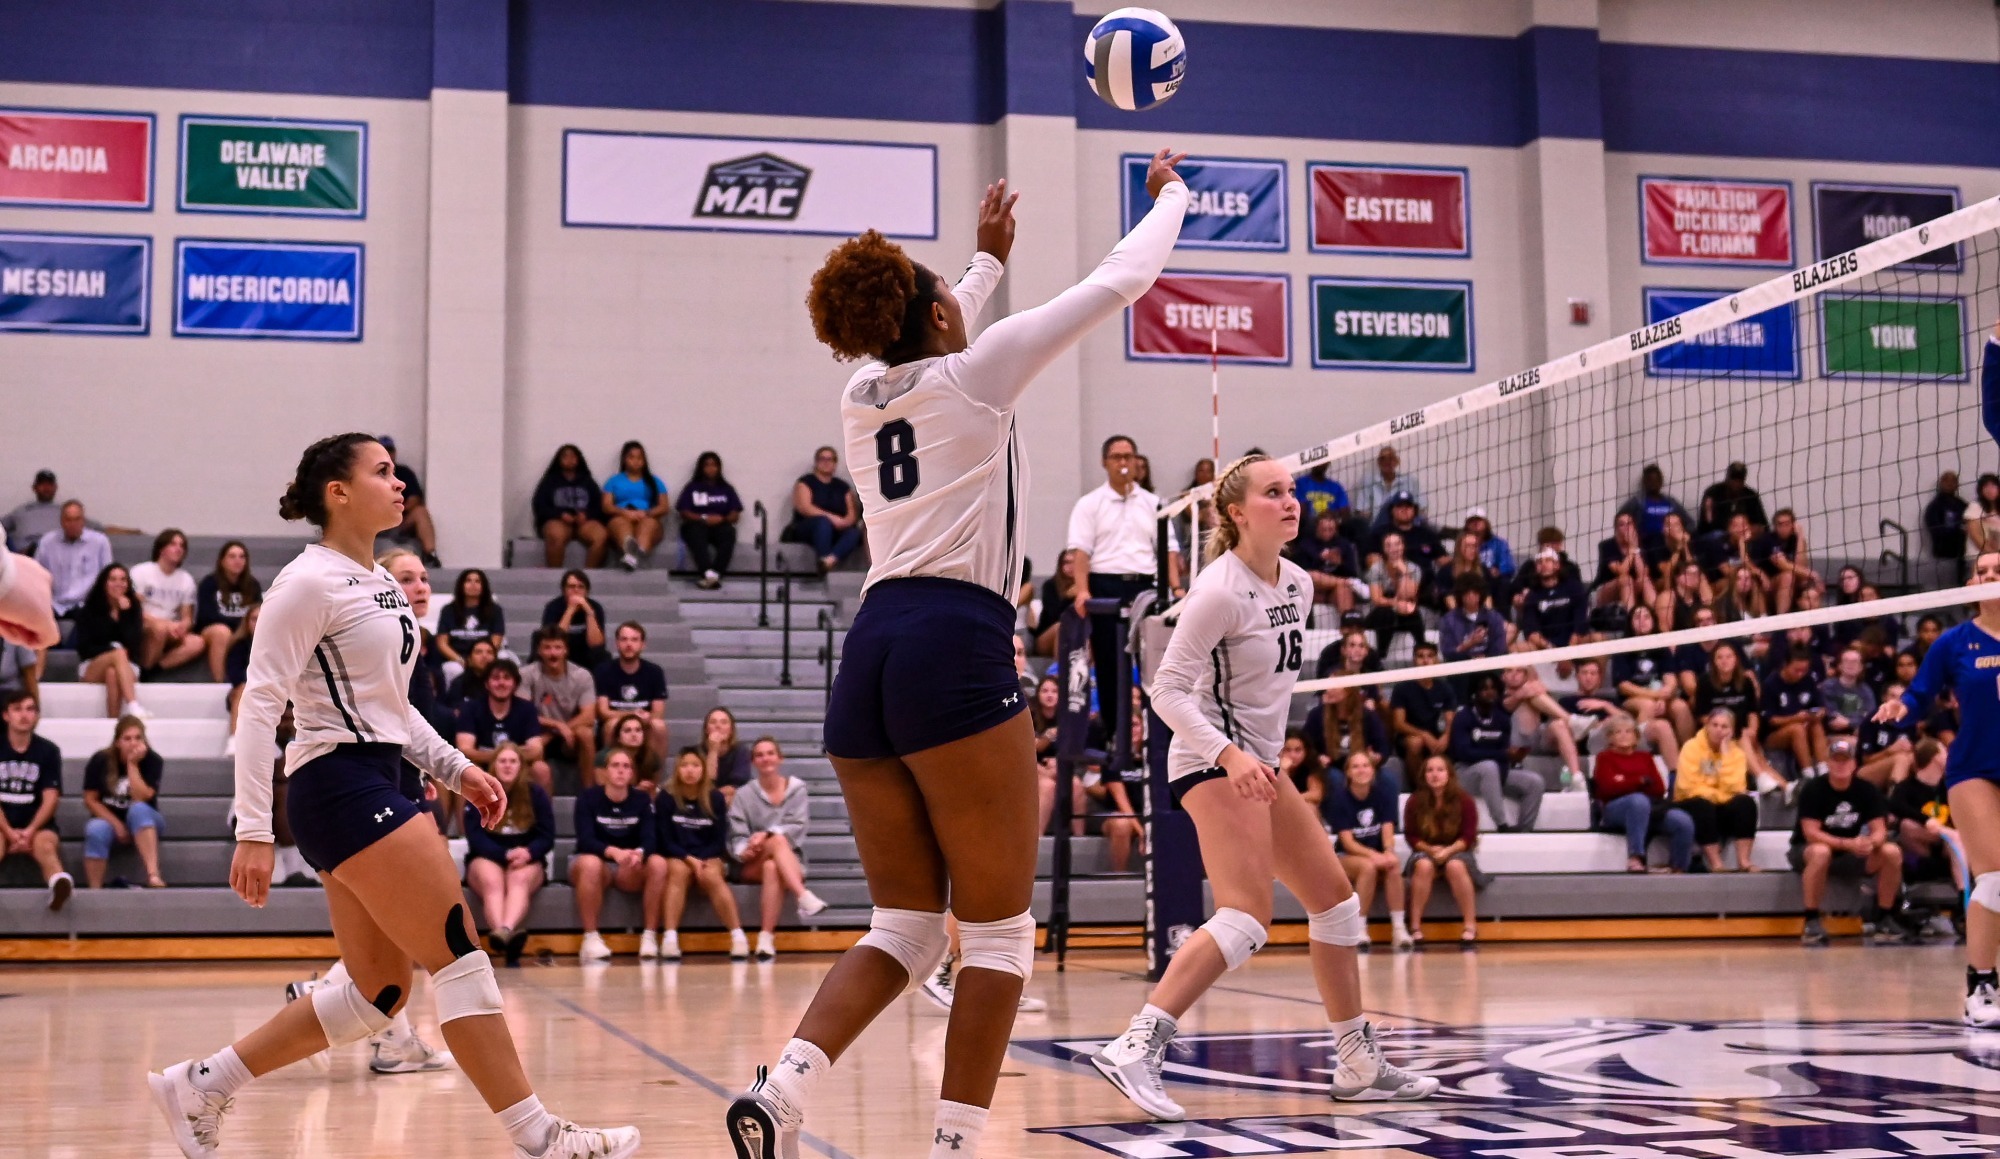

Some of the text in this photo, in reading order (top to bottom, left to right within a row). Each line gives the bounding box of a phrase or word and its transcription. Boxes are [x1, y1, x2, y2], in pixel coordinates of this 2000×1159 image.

[8, 145, 108, 174] ARCADIA
[220, 140, 326, 168] DELAWARE
[236, 166, 310, 191] VALLEY
[701, 184, 799, 216] MAC
[1345, 197, 1433, 224] EASTERN
[1675, 188, 1757, 212] FAIRLEIGH
[1674, 211, 1761, 234] DICKINSON
[1680, 232, 1757, 256] FLORHAM
[2, 268, 105, 298] MESSIAH
[1793, 251, 1858, 292] BLAZERS
[188, 274, 350, 306] MISERICORDIA
[1165, 303, 1253, 331] STEVENS
[1334, 310, 1450, 338] STEVENSON
[1630, 317, 1682, 351] BLAZERS
[1869, 325, 1917, 350] YORK
[1499, 368, 1541, 396] BLAZERS
[1390, 409, 1426, 435] BLAZERS
[874, 417, 921, 503] 8
[1265, 602, 1301, 629] HOOD
[398, 613, 415, 666] 6
[1273, 628, 1303, 674] 16
